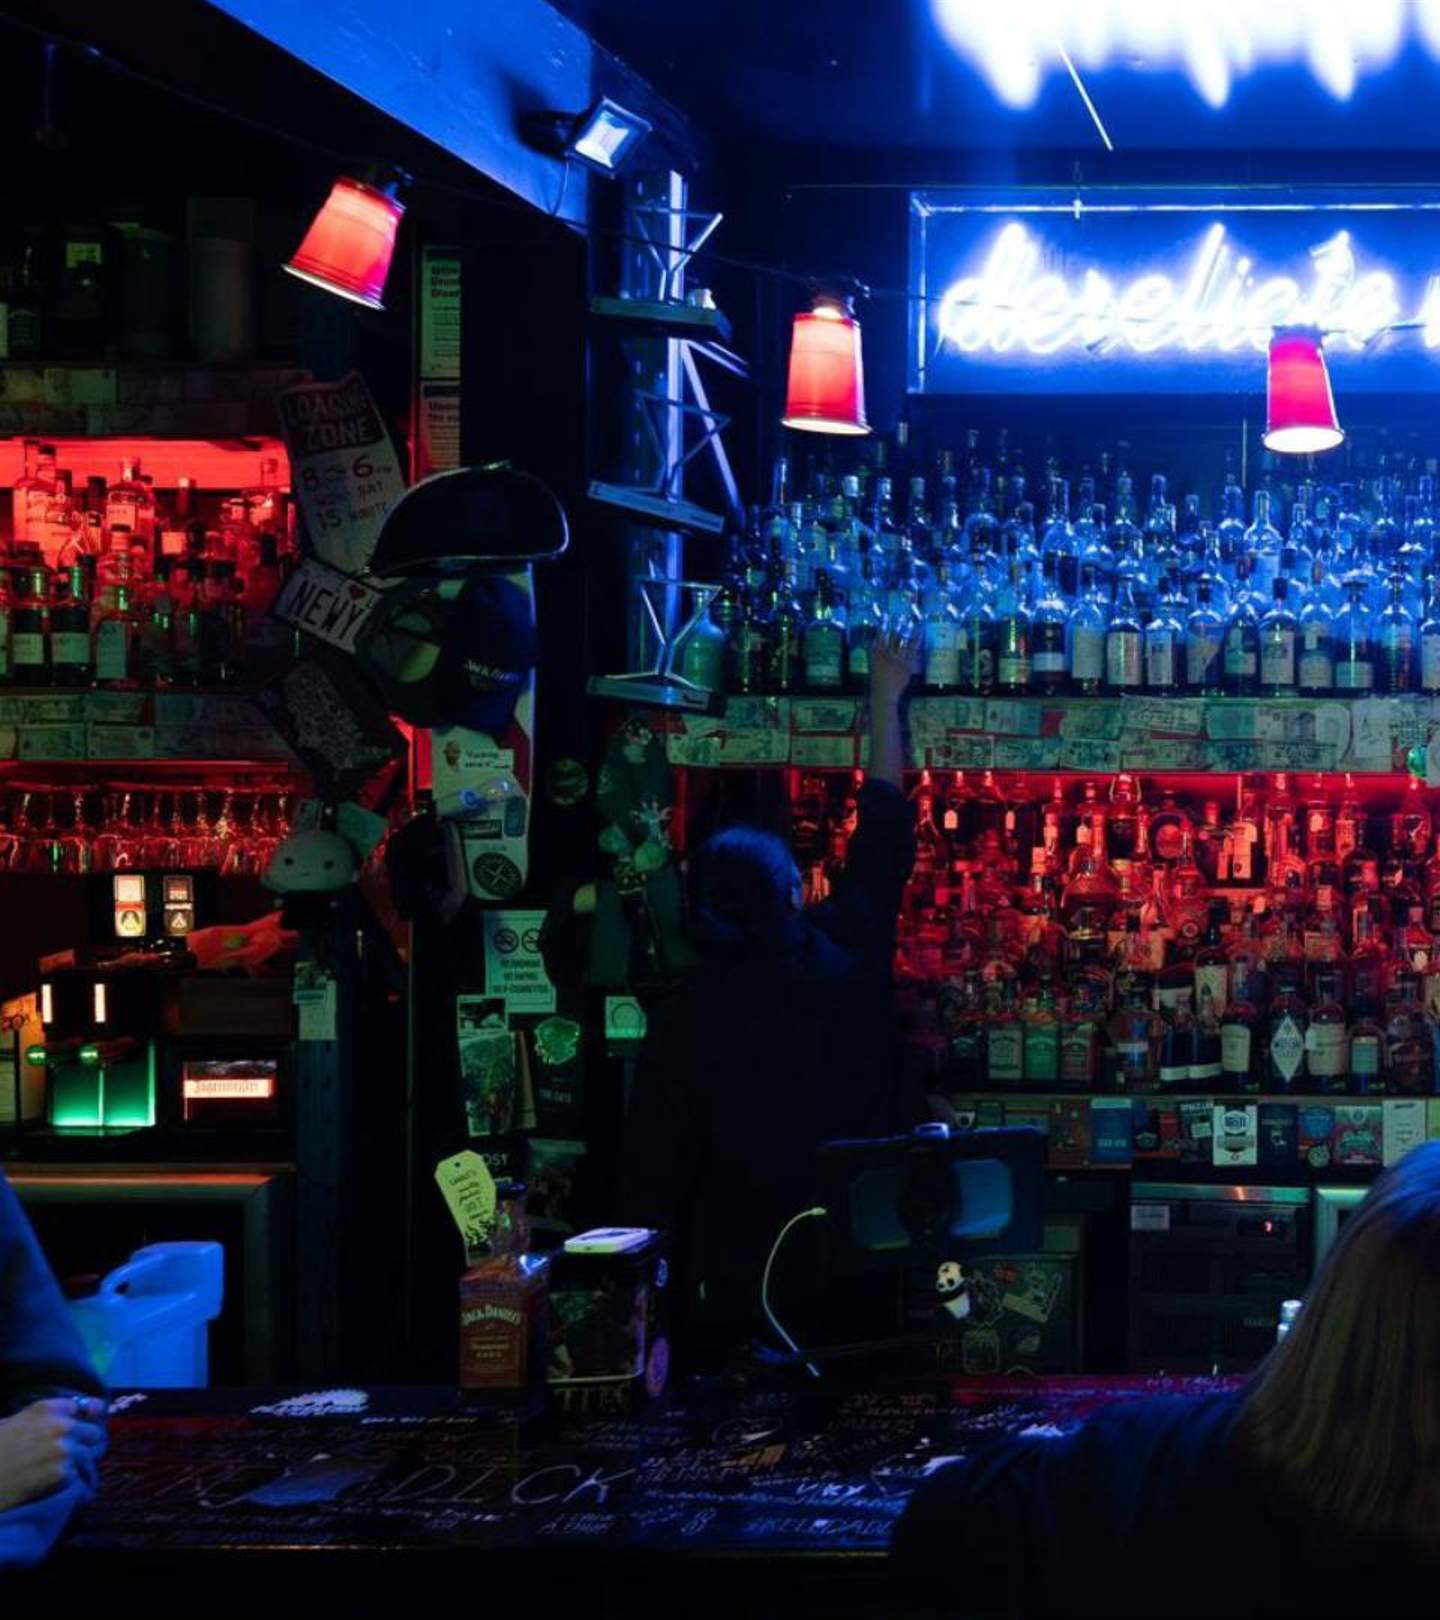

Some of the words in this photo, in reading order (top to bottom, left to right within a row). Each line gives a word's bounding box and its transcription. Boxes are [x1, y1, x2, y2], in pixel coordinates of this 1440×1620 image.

[305, 416, 375, 450] ZONE
[353, 454, 374, 478] 6
[289, 579, 368, 641] NEWY
[380, 1464, 637, 1505] DICK
